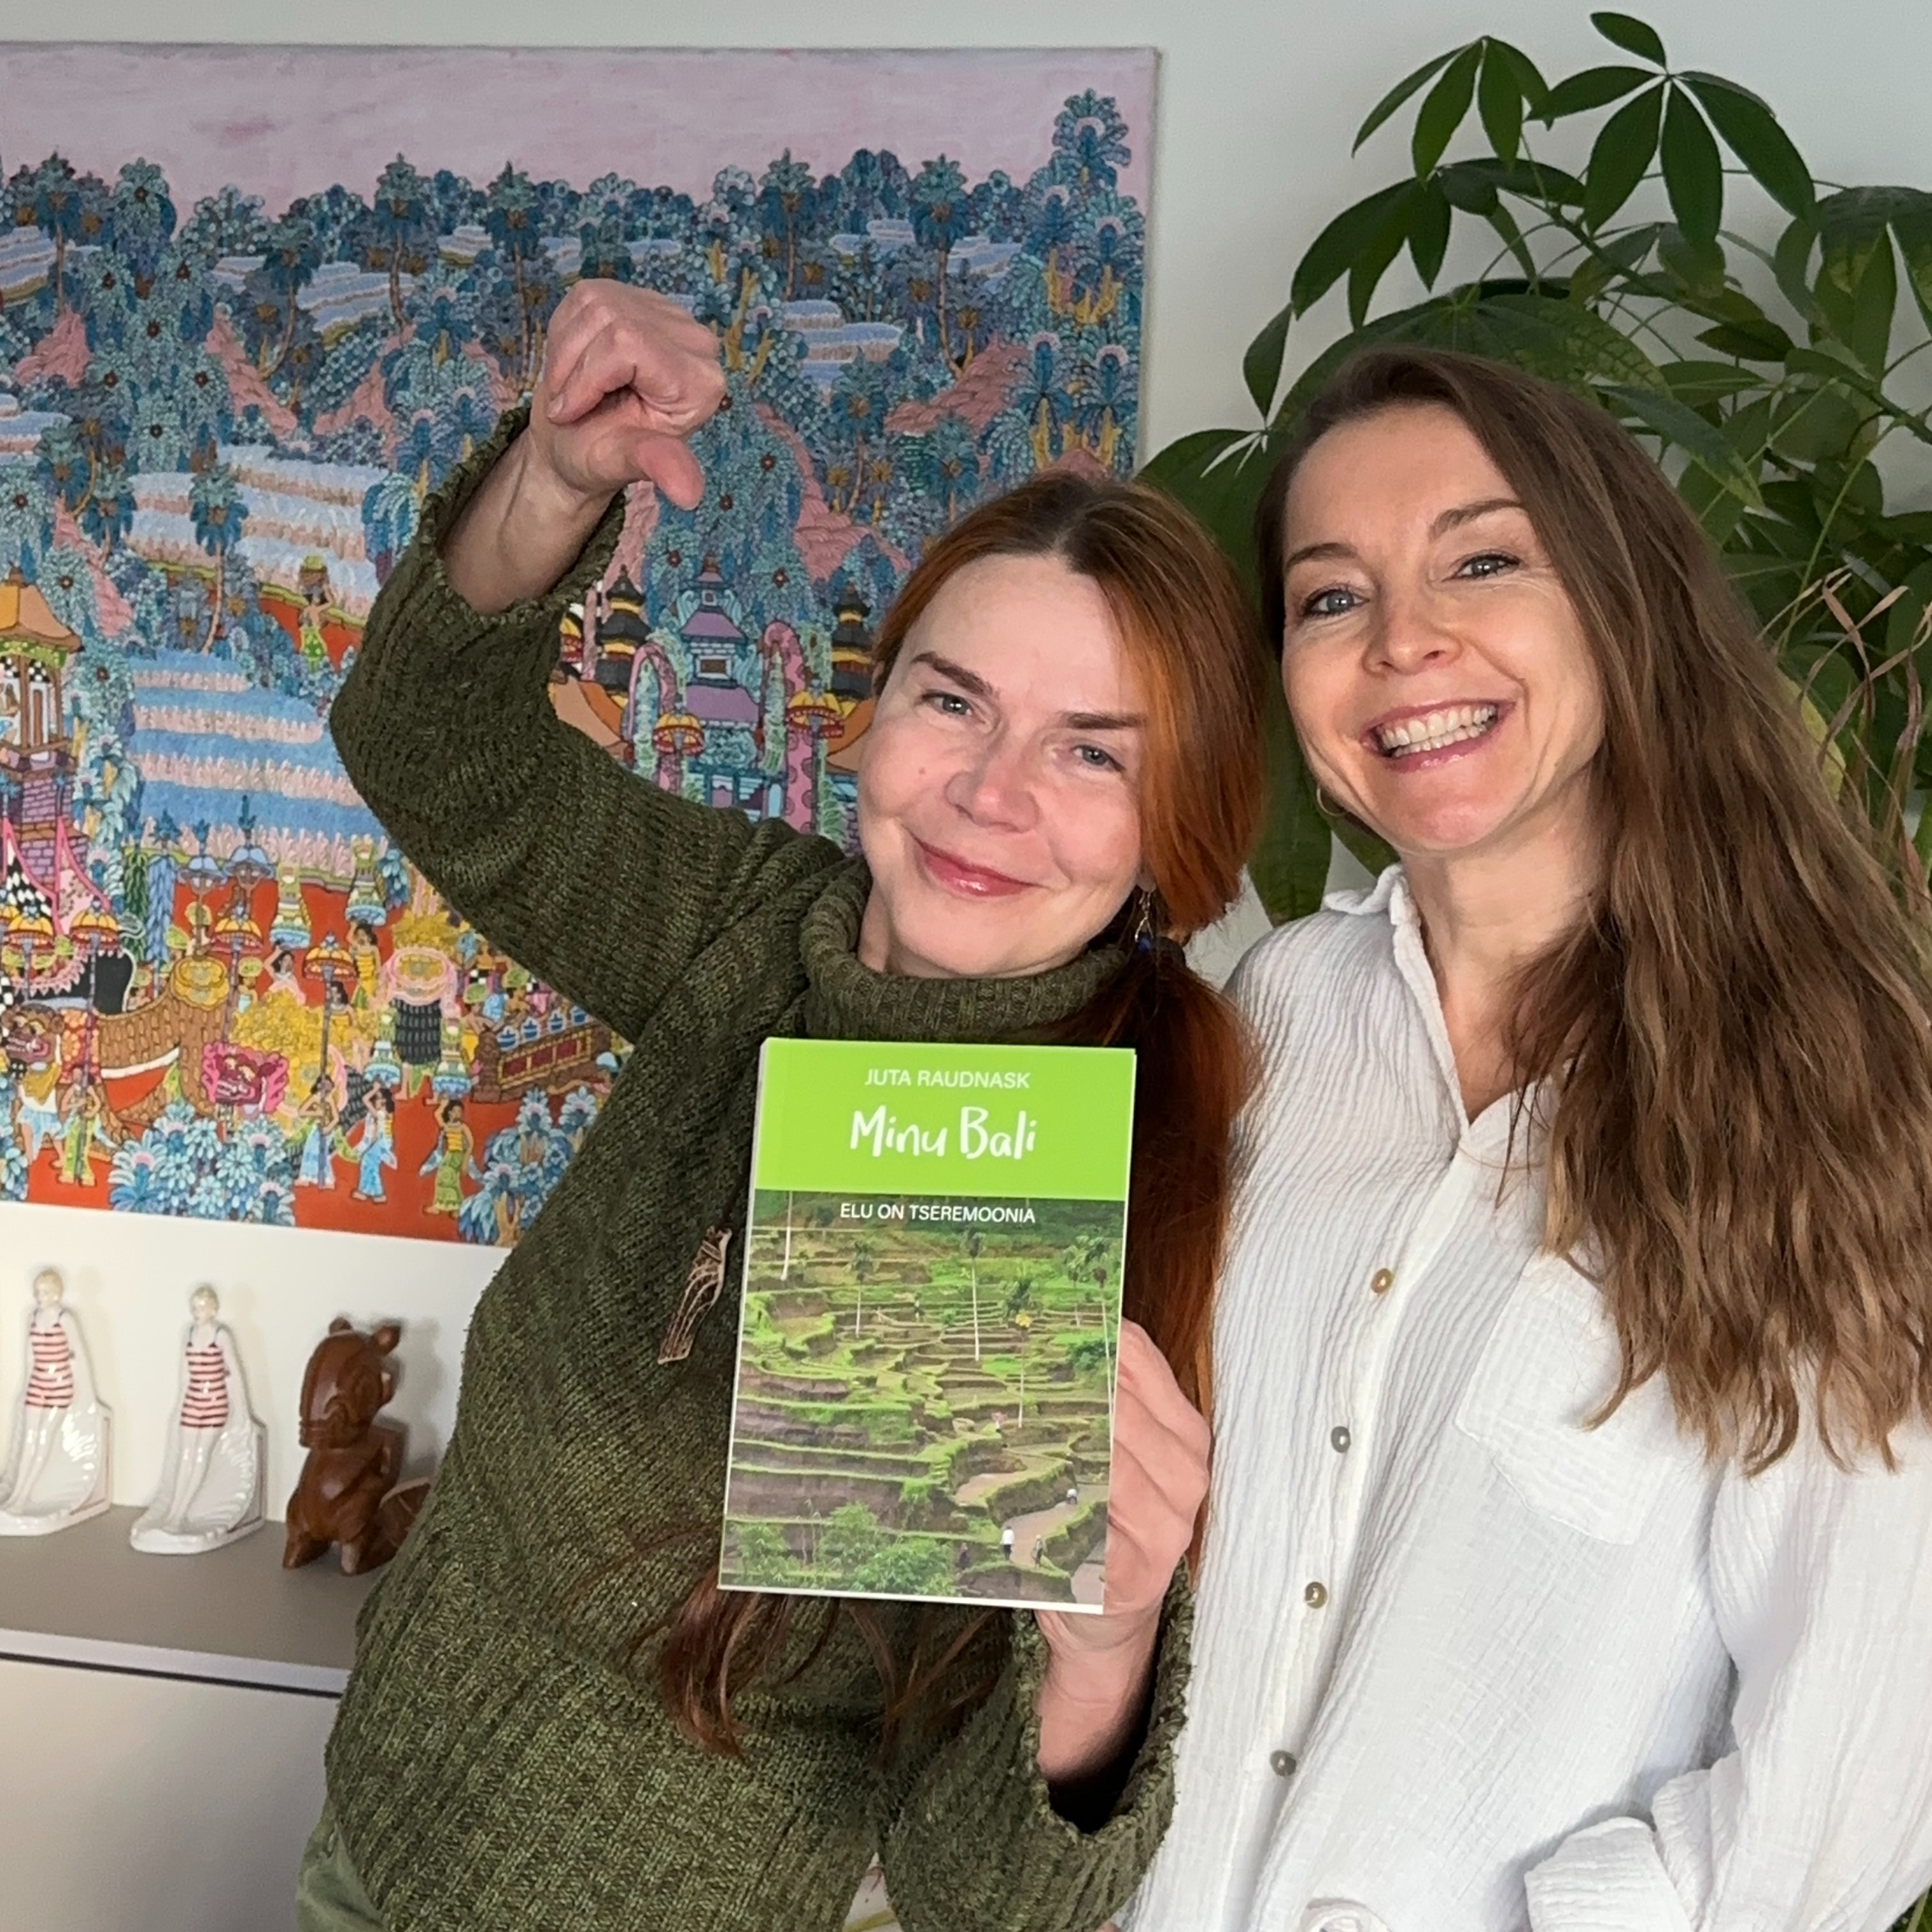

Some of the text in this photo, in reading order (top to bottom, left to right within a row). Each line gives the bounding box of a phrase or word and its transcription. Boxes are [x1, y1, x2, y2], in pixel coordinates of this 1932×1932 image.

[864, 1069, 1030, 1088] JUTA RAUDNASK
[850, 1105, 1037, 1160] Minu Bali
[840, 1202, 1036, 1224] ELU ON TSEREMOONIA
